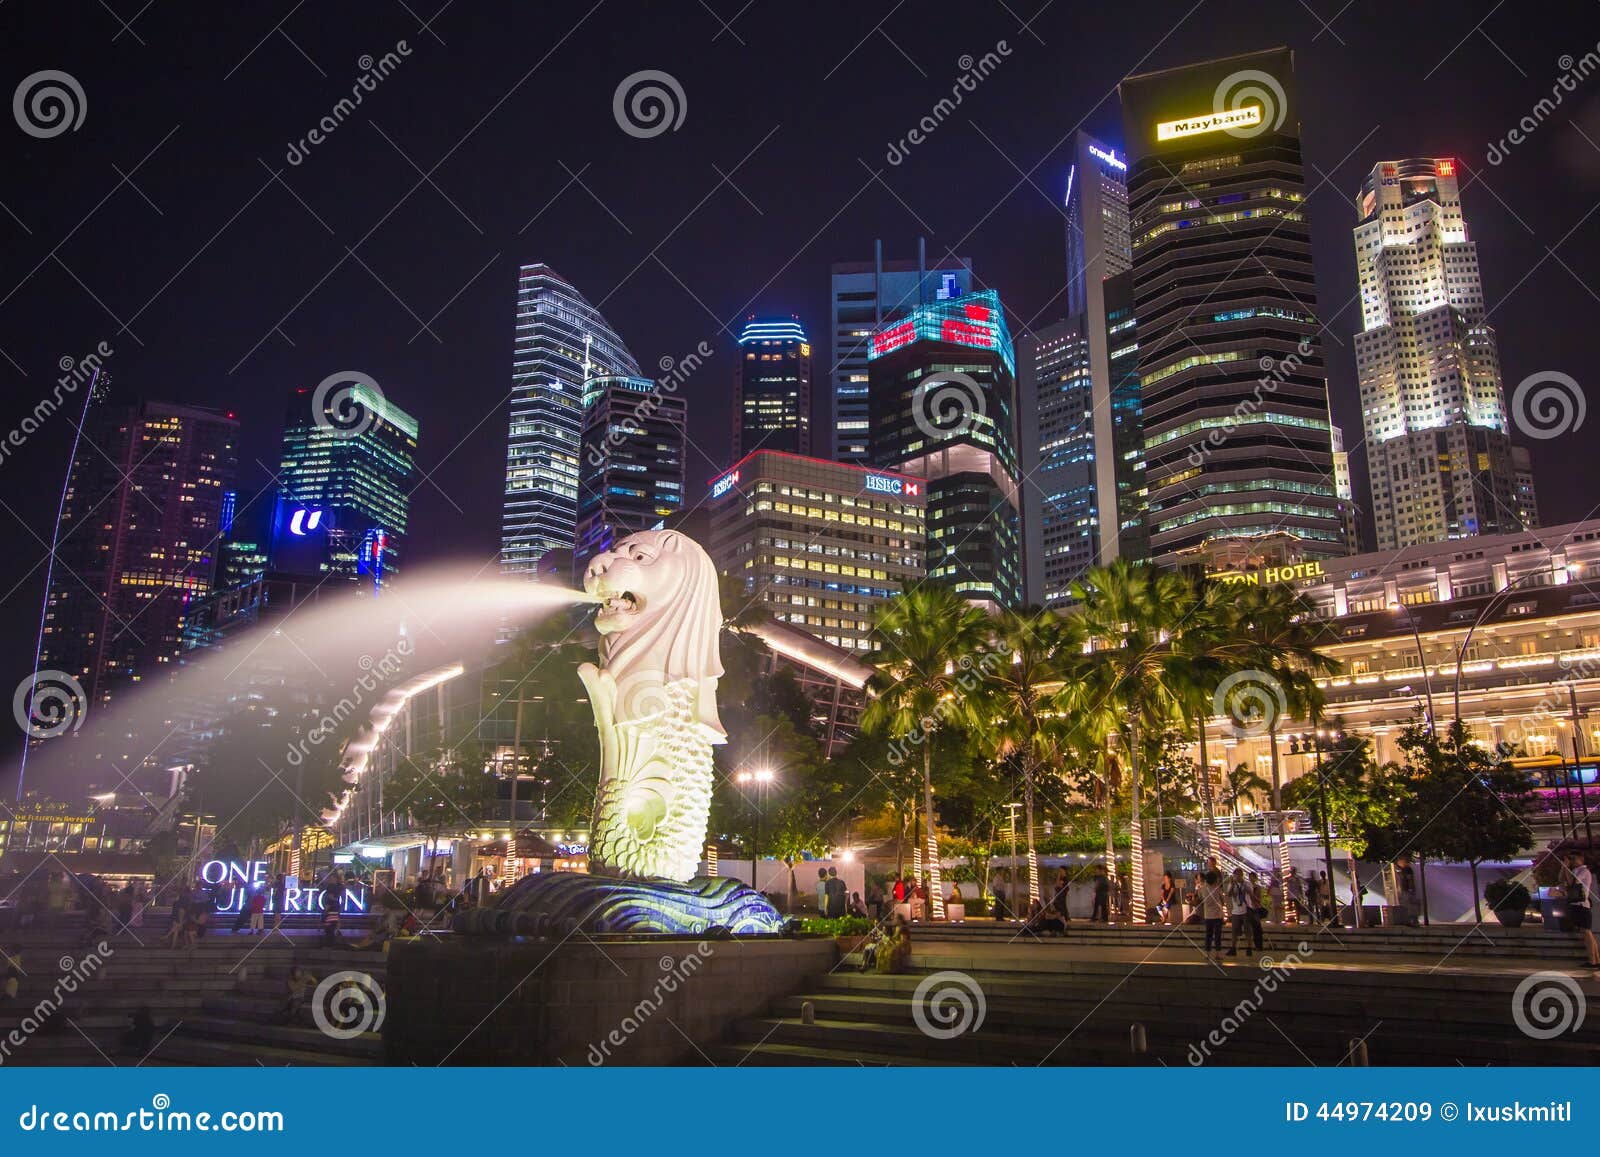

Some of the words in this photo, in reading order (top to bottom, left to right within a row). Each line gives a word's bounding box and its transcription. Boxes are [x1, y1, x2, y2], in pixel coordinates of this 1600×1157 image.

[1175, 111, 1257, 132] Maybank
[866, 475, 902, 494] HSBC
[1265, 561, 1325, 584] HOTEL
[202, 860, 268, 884] ONE
